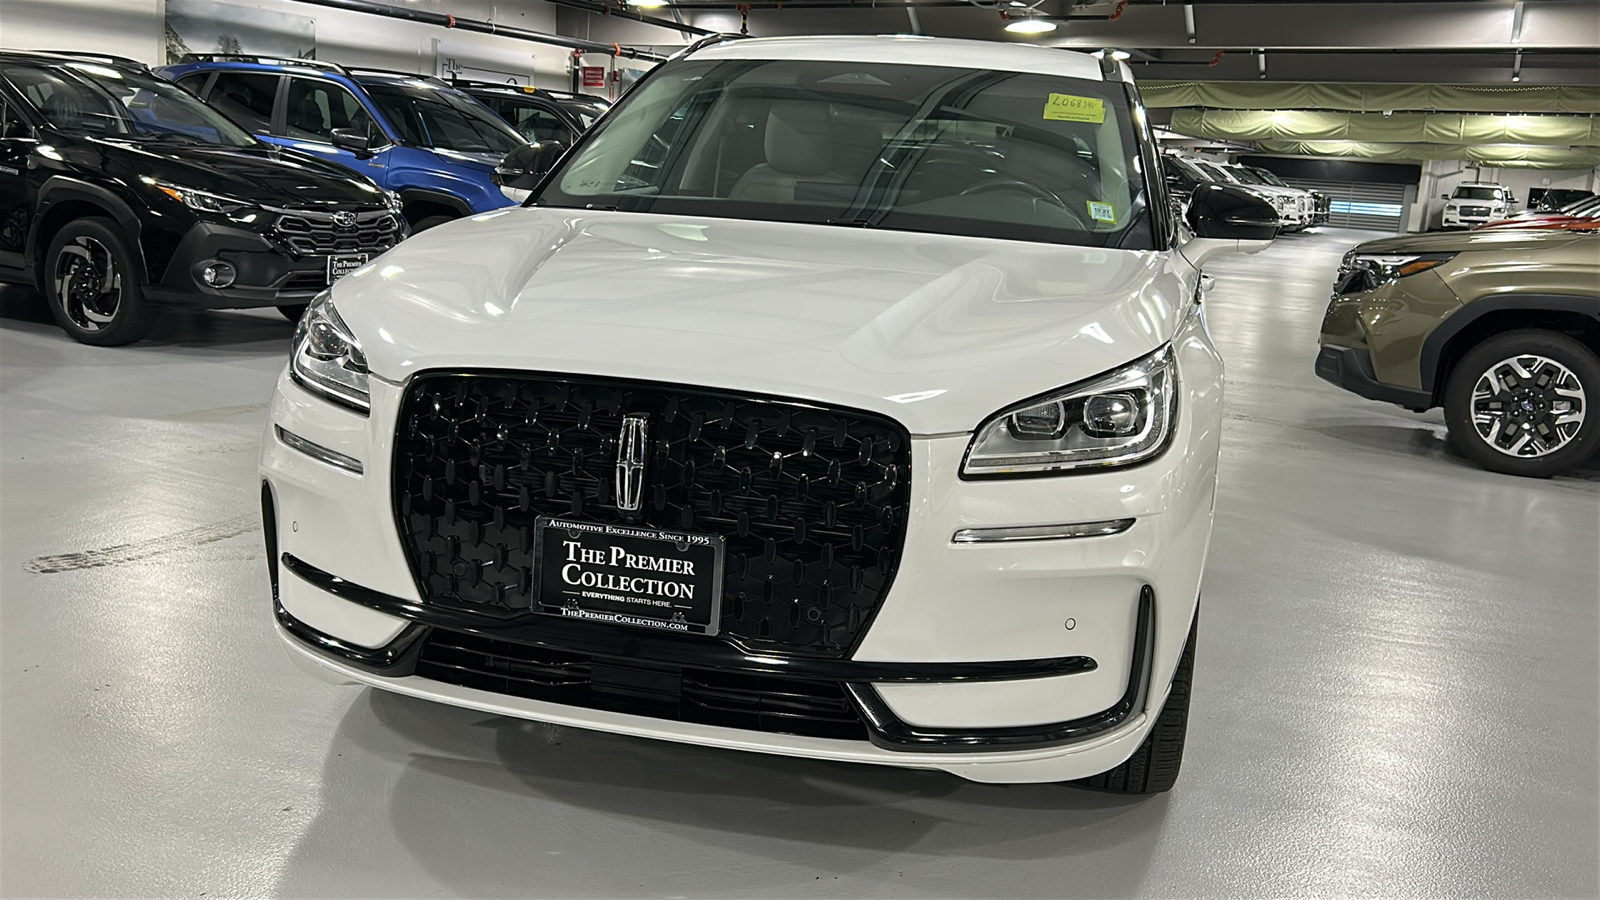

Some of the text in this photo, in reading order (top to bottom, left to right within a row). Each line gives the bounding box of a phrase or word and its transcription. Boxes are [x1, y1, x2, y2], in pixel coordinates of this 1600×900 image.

[549, 519, 710, 545] AUTOMOTIVE EXCELLENCE SINCE 1995
[562, 540, 695, 576] THE PREMIER
[561, 563, 695, 600] COLLECTION
[582, 591, 625, 603] EVERYTHING
[626, 596, 651, 606] STARTS
